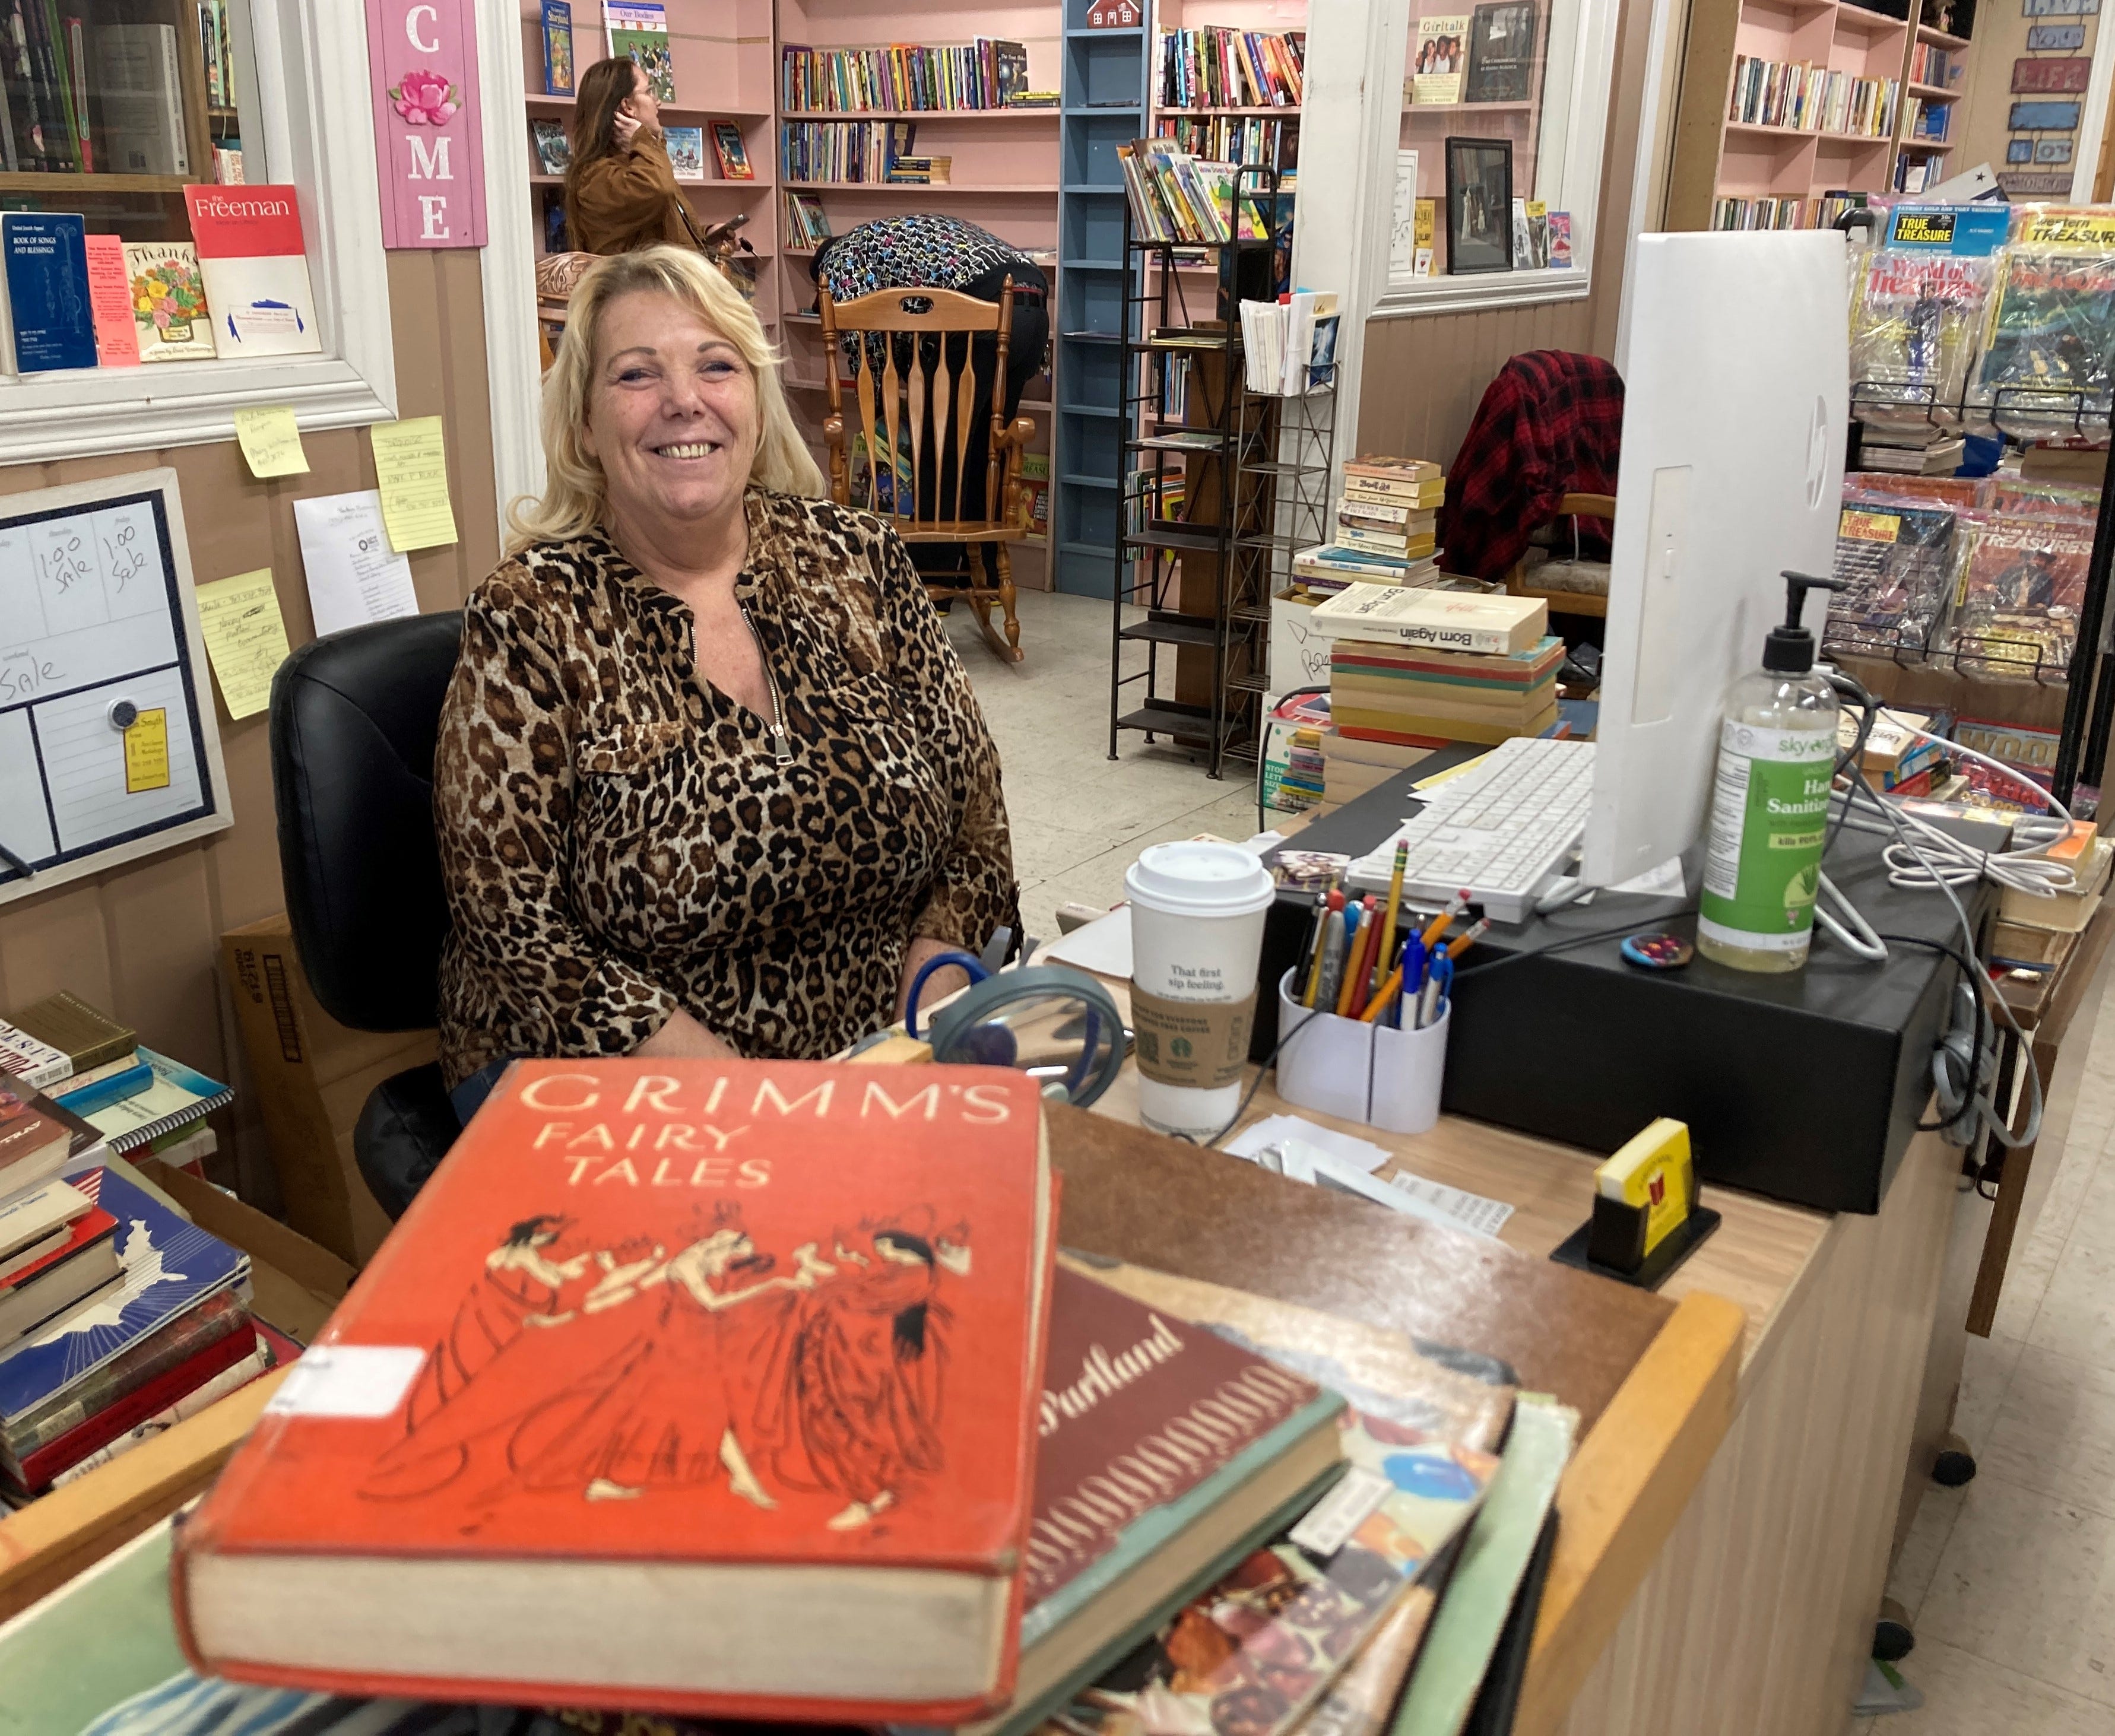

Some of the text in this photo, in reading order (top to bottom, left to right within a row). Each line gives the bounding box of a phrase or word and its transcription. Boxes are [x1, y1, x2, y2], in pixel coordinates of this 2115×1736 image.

[620, 9, 654, 19] Our Bodies
[1424, 20, 1465, 31] Girltalk
[2016, 65, 2082, 89] LIFE
[195, 199, 290, 217] Freeman
[1902, 218, 1929, 229] TRUE
[1897, 229, 1952, 241] TREASURE
[1892, 259, 1970, 280] World of
[1869, 268, 1981, 298] Treaures
[1847, 516, 1873, 526] TRUE
[1843, 525, 1895, 541] TREASURE
[1977, 532, 2094, 556] TREASURES
[1400, 627, 1472, 646] Born Again
[1778, 736, 1807, 756] sky
[1171, 964, 1221, 977] That first
[1168, 979, 1184, 989] sip
[519, 1072, 1013, 1125] GRIMM'S
[531, 1121, 753, 1153] FAIRY
[563, 1155, 773, 1188] TALES
